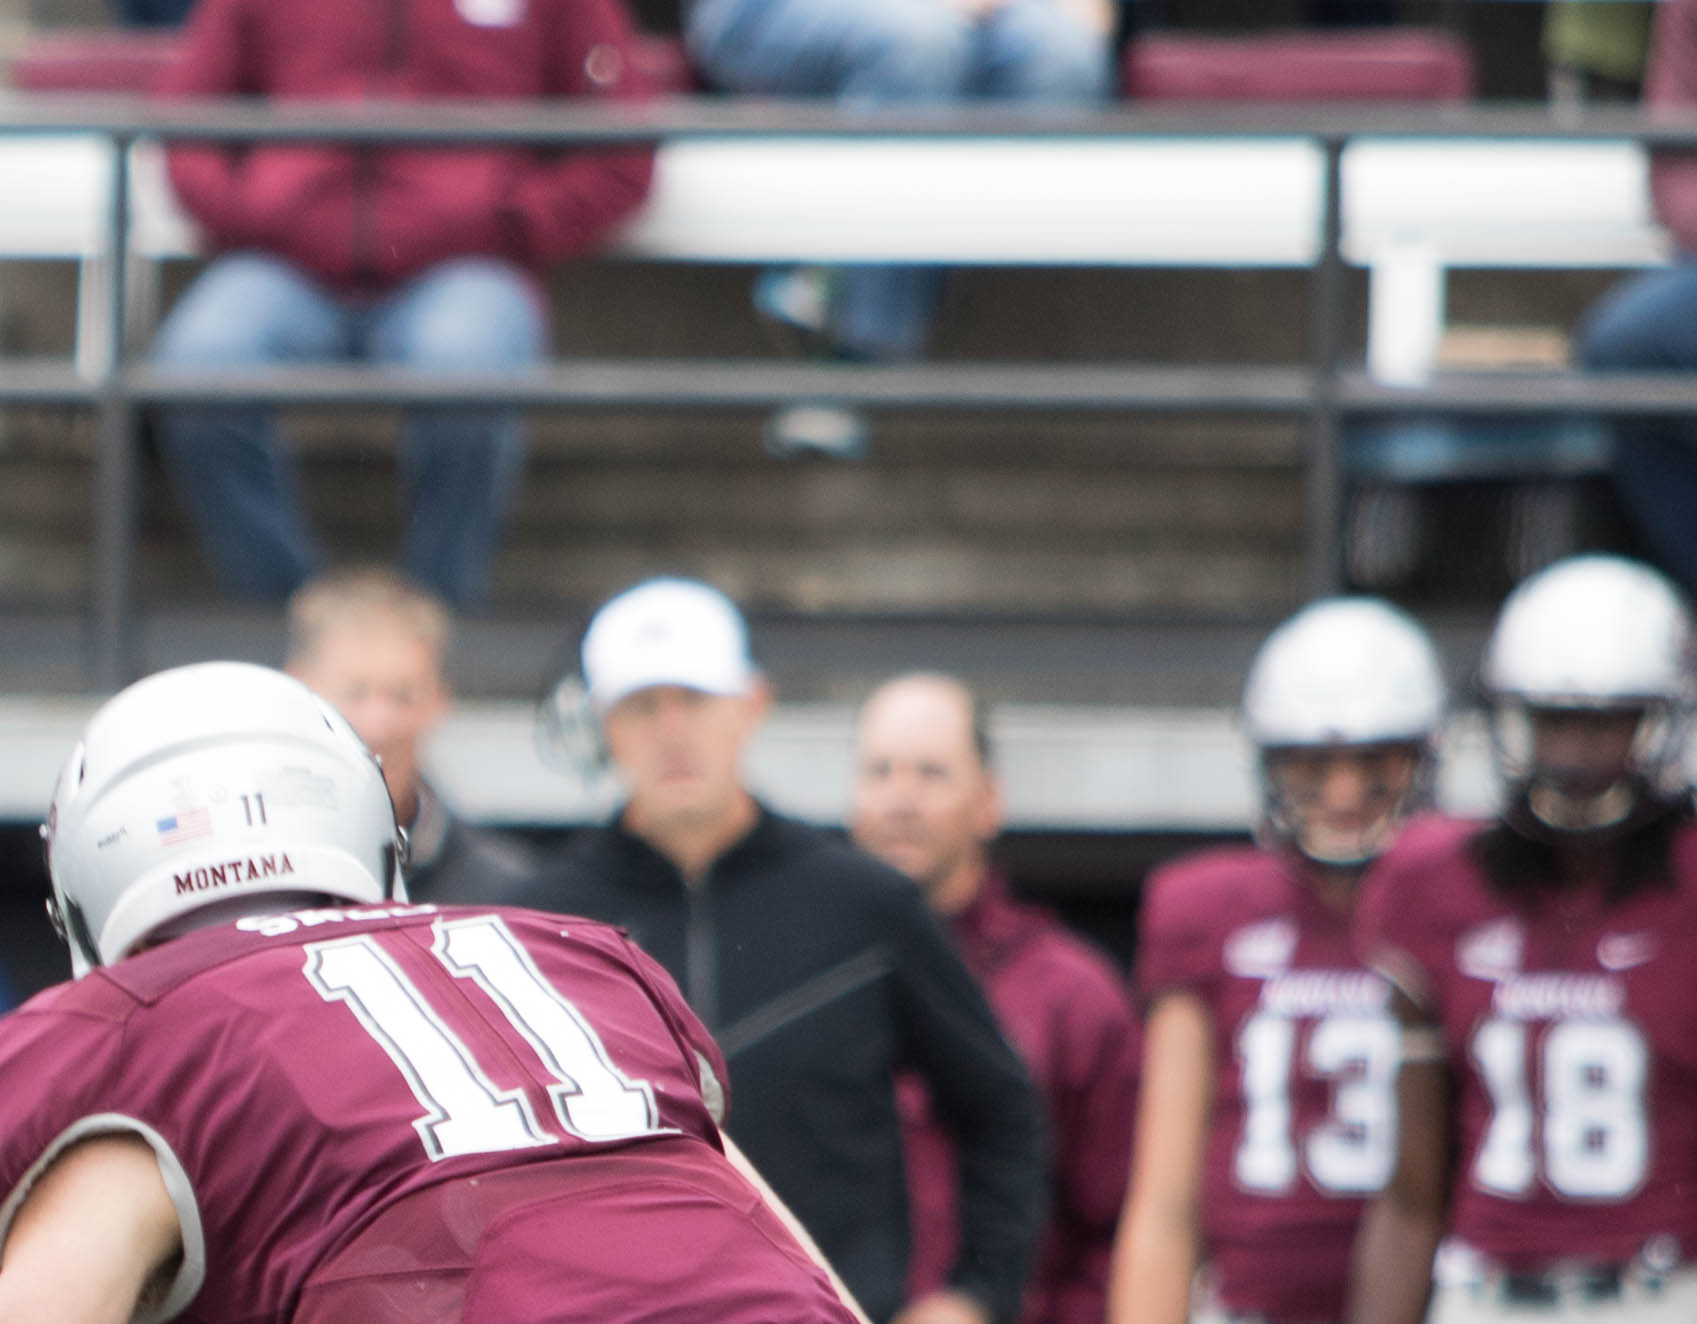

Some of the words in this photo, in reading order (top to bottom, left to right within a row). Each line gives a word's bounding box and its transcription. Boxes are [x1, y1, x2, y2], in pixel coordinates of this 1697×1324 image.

[173, 852, 295, 895] MONTANA
[240, 792, 267, 827] 11
[303, 915, 682, 1161] 11
[1235, 1009, 1400, 1192] 13
[1470, 1012, 1648, 1197] 18
